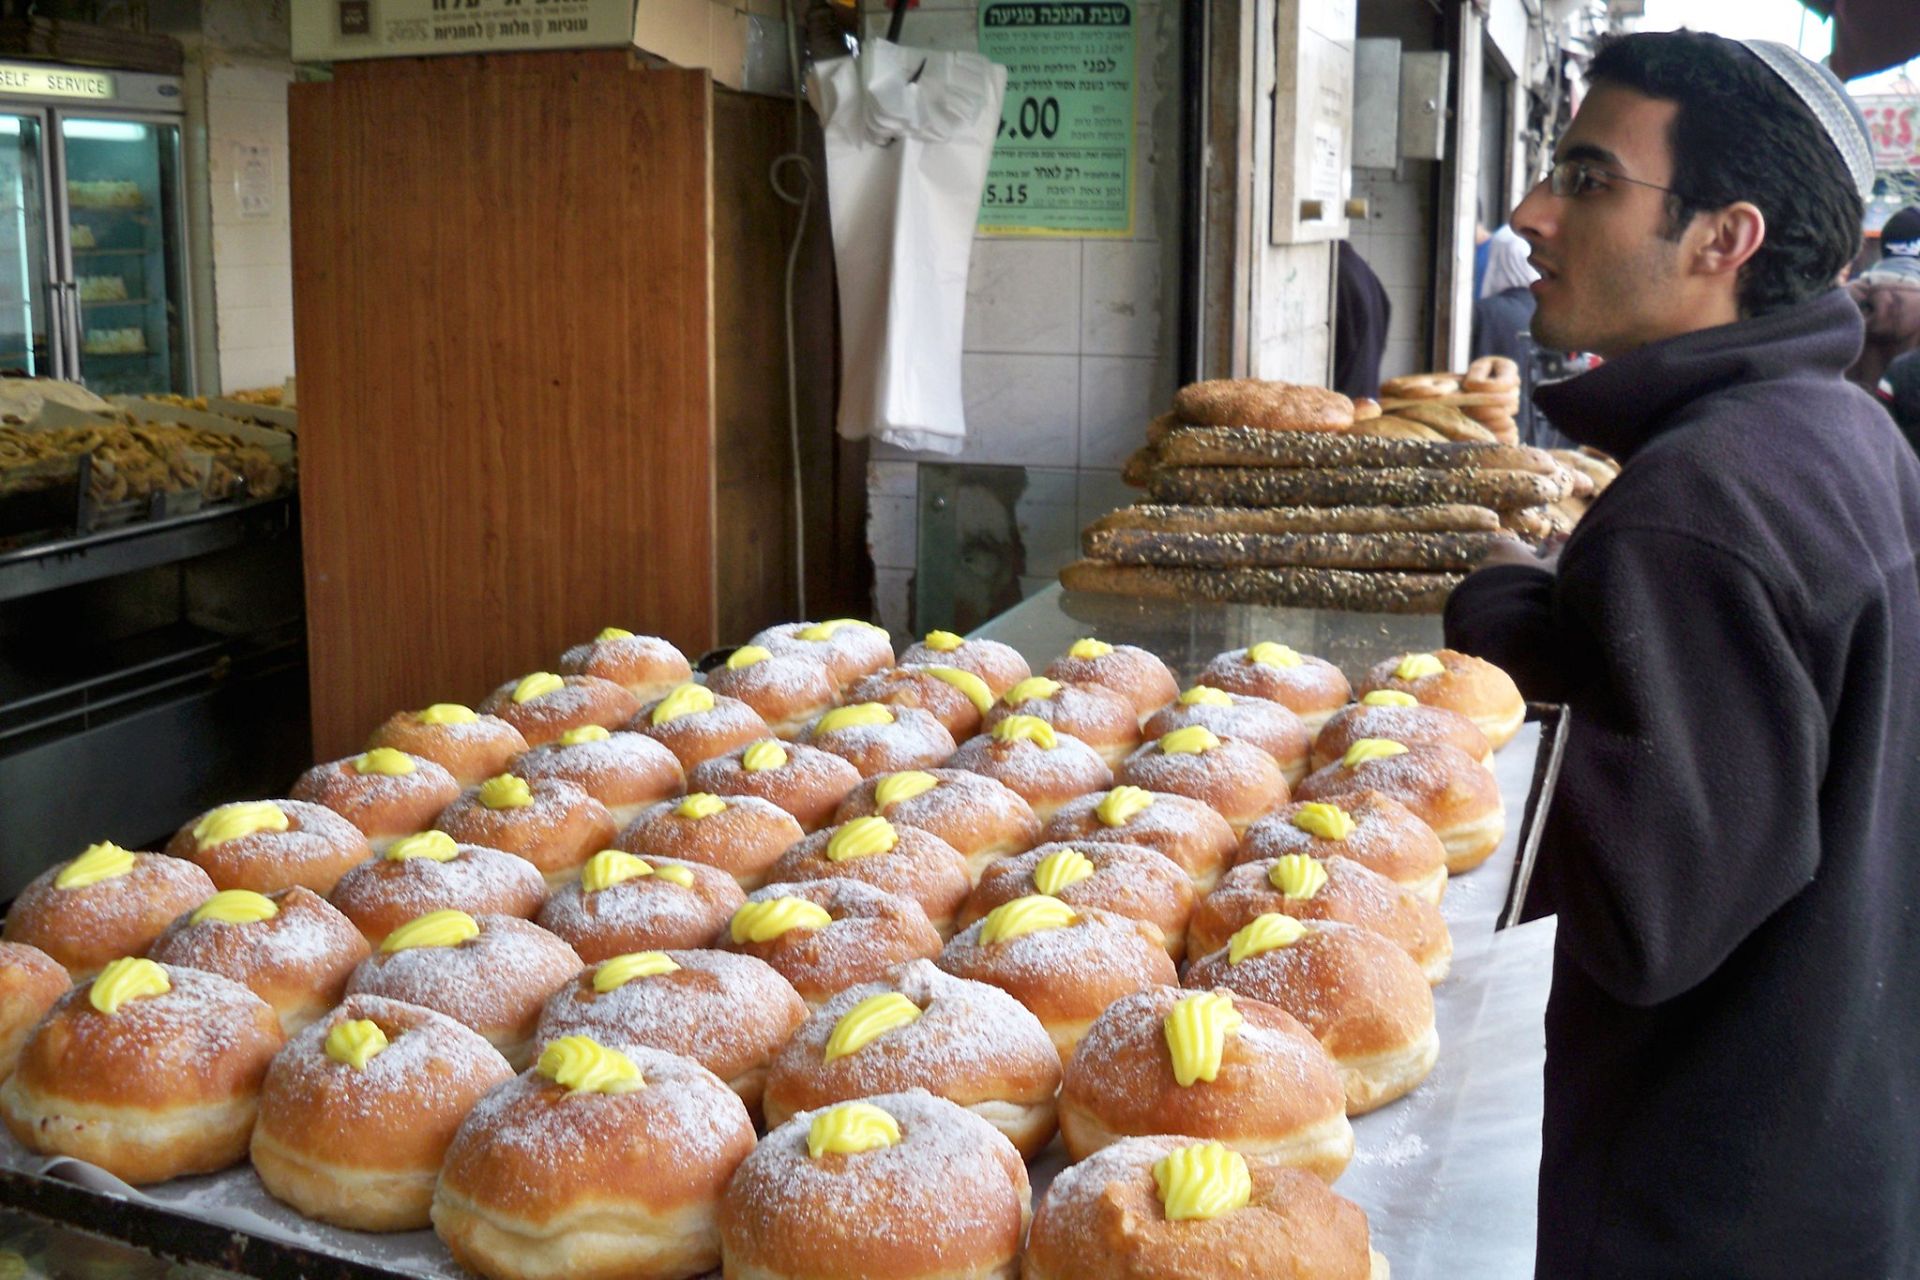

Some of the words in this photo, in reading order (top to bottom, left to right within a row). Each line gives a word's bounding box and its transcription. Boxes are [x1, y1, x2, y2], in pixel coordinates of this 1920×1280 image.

[988, 7, 1036, 25] מגיעה
[1040, 6, 1085, 24] חנוכה
[1089, 6, 1127, 24] שבת
[1083, 56, 1117, 73] לפני
[47, 75, 106, 95] SERVICE
[1033, 164, 1062, 179] לאחר
[1064, 167, 1080, 181] רק
[986, 183, 1029, 204] 5.15
